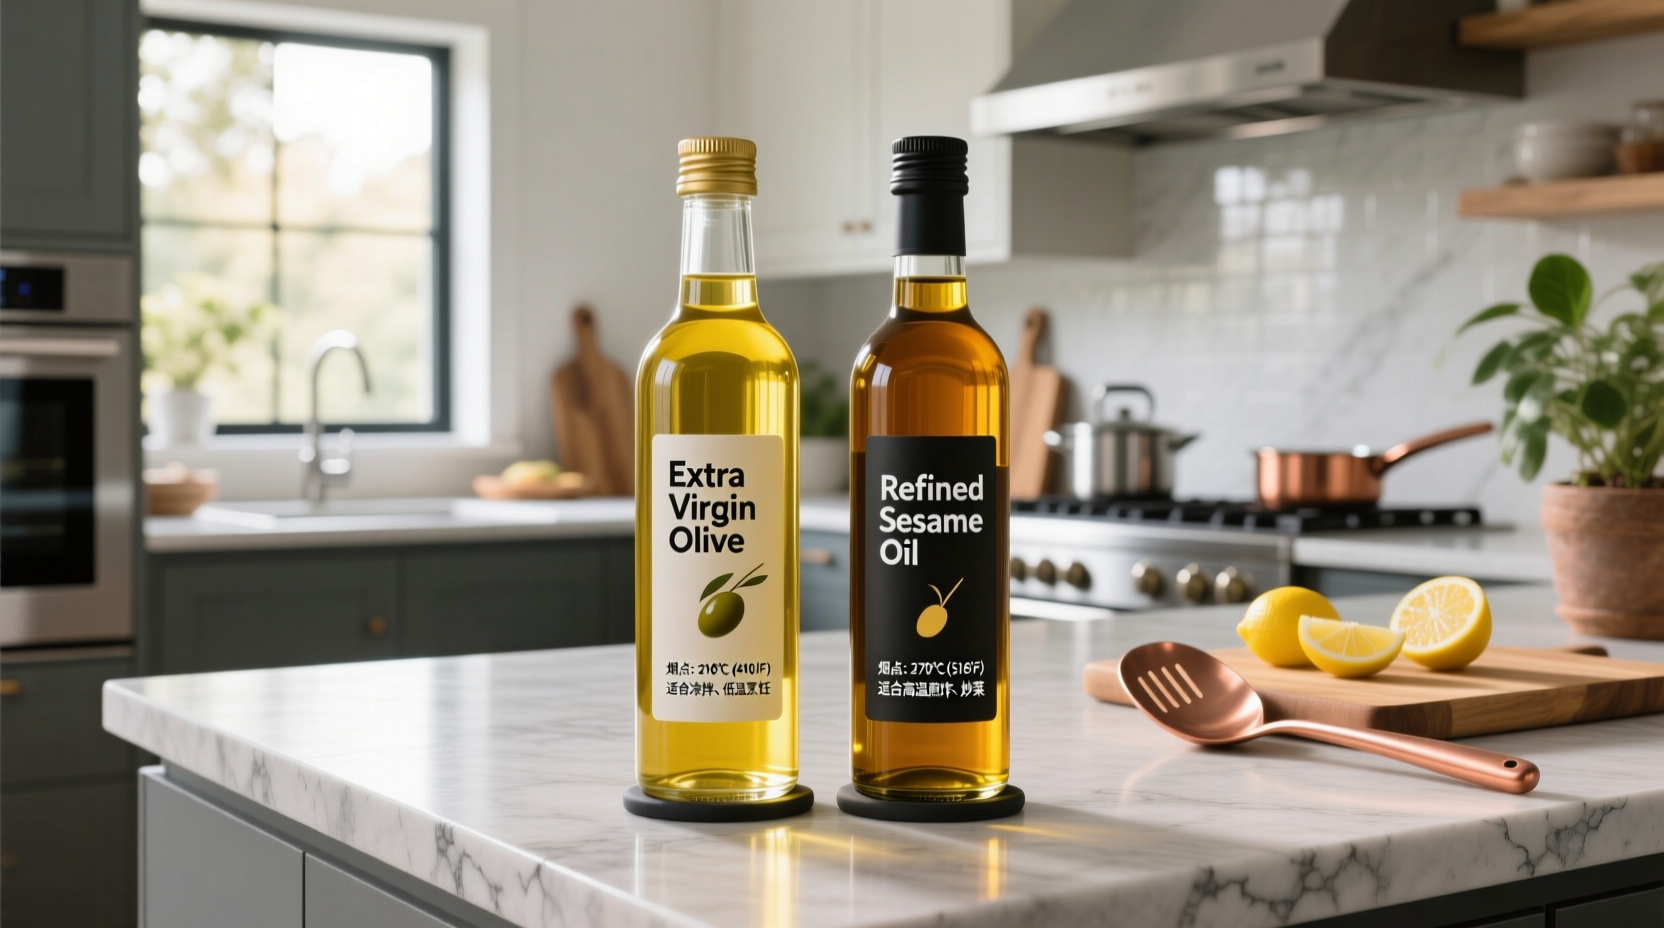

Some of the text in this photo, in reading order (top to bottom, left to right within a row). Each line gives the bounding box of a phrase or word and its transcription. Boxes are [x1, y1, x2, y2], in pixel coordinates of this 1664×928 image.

[669, 460, 745, 488] Extra
[880, 474, 984, 501] Refined
[669, 493, 756, 527] Virgin
[879, 506, 984, 534] Sesame
[669, 526, 745, 553] Olive
[879, 538, 918, 566] Oil
